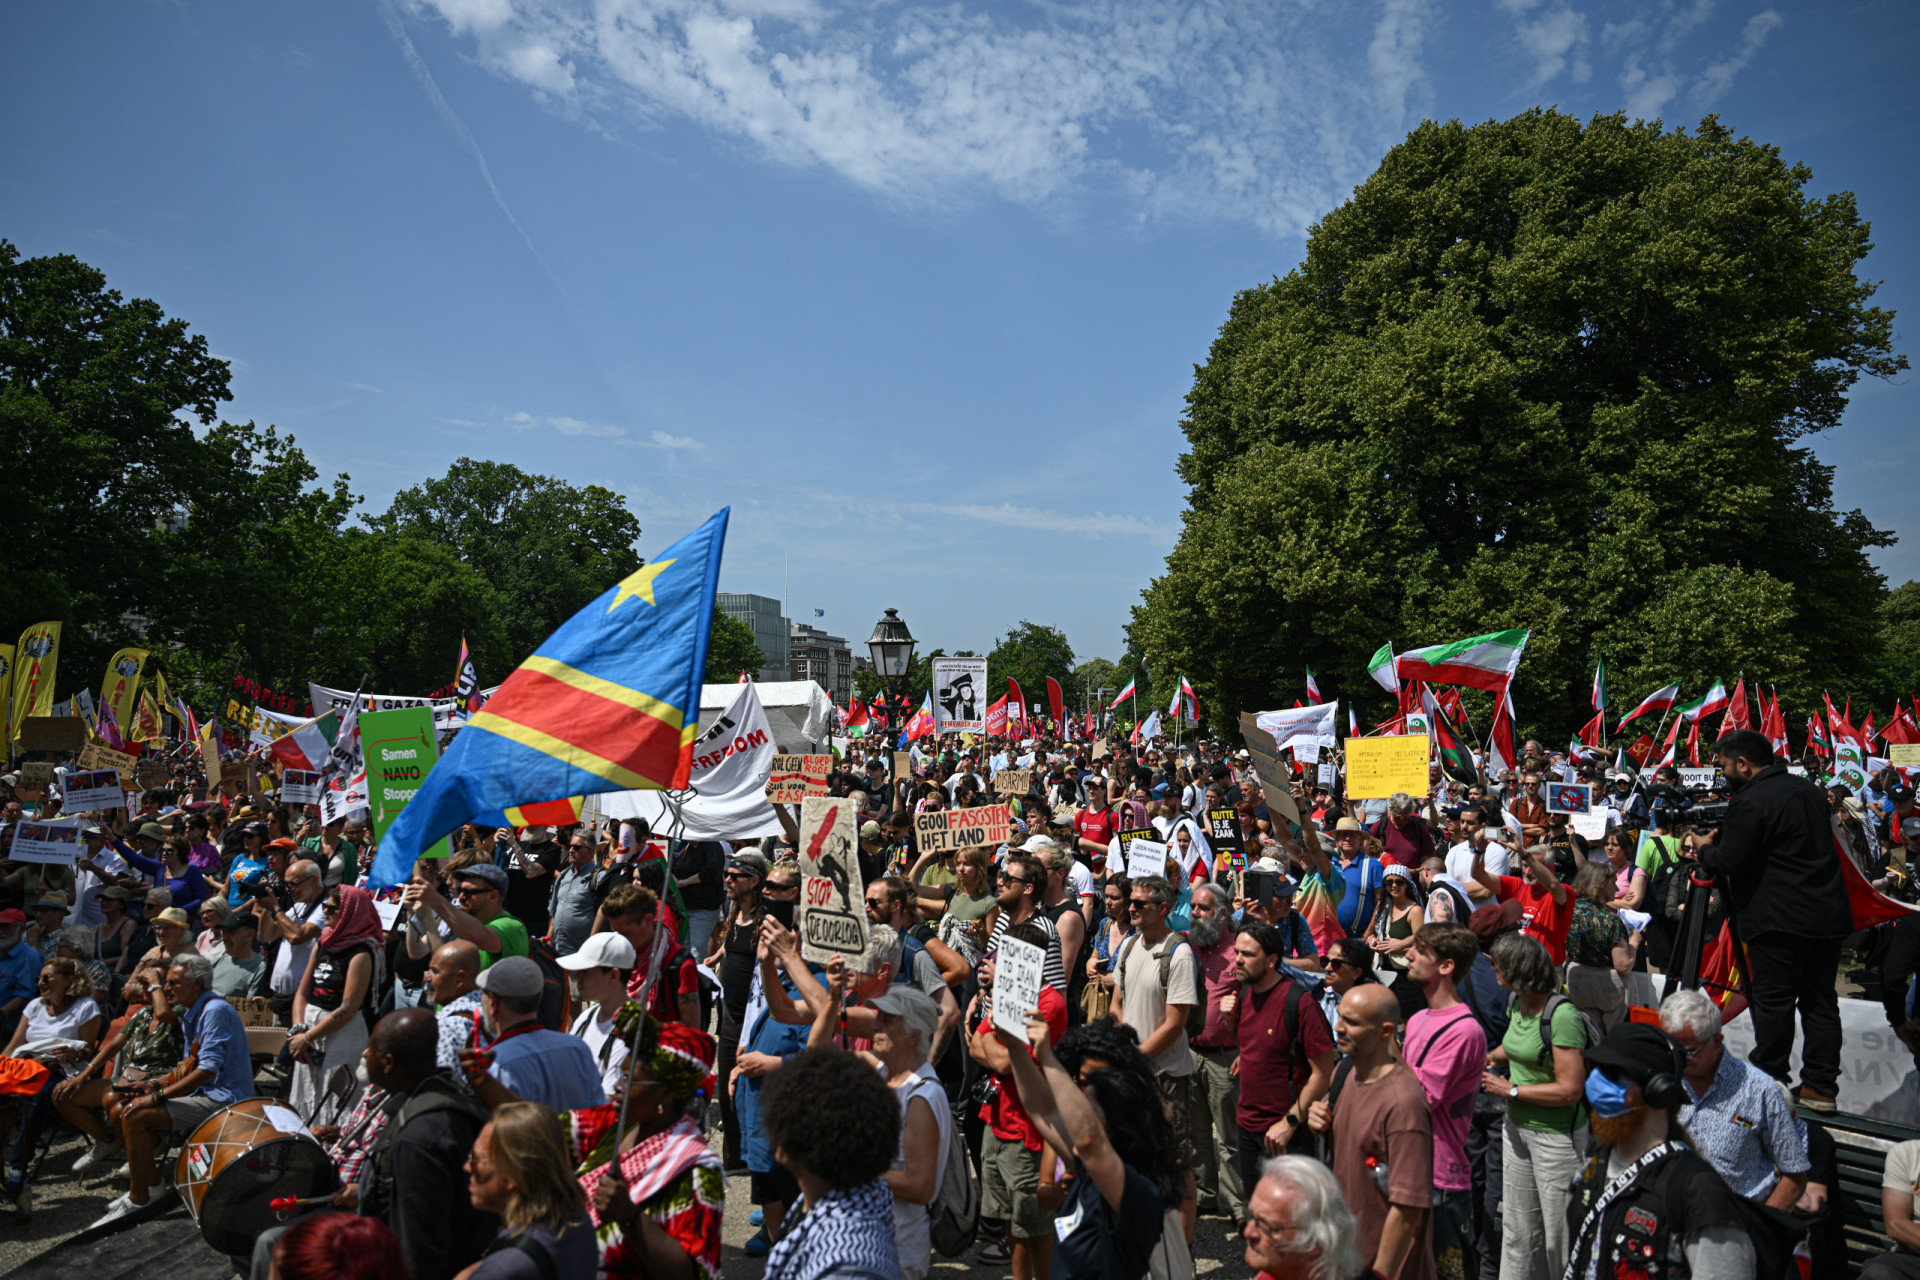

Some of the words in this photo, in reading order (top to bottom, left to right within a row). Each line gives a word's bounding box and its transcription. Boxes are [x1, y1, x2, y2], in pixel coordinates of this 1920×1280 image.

[331, 699, 376, 709] FRM
[382, 700, 424, 709] GAZA
[227, 699, 297, 738] RESIST
[381, 748, 417, 761] Samen
[691, 729, 768, 770] FREDOM
[785, 756, 803, 773] GEEN
[804, 764, 829, 775] RODE
[383, 765, 420, 782] NAVO
[1840, 772, 1862, 789] IRAN
[1845, 770, 1859, 780] NO
[1838, 779, 1856, 792] WAR
[777, 790, 829, 802] FASCISTE
[917, 814, 947, 831] GOOI
[1211, 810, 1235, 820] RUTTE
[1213, 821, 1221, 829] IS
[1222, 820, 1230, 829] JE
[921, 831, 948, 850] HET
[953, 828, 984, 847] LAND
[989, 825, 1008, 841] UIT
[1121, 830, 1152, 842] RUTTE
[1214, 829, 1235, 838] ZAAK
[807, 876, 833, 907] STOP
[809, 915, 821, 940] DE
[823, 917, 860, 947] OORLOG
[1001, 939, 1021, 961] FROM
[1022, 945, 1041, 967] GAZA
[1004, 960, 1013, 973] TO
[998, 974, 1014, 993] STOP
[1017, 985, 1028, 1003] THE
[1640, 1142, 1668, 1167] ALDI
[1615, 1162, 1639, 1188] ALDI
[1594, 1185, 1616, 1213] ALDI
[1580, 1209, 1595, 1237] ALDI
